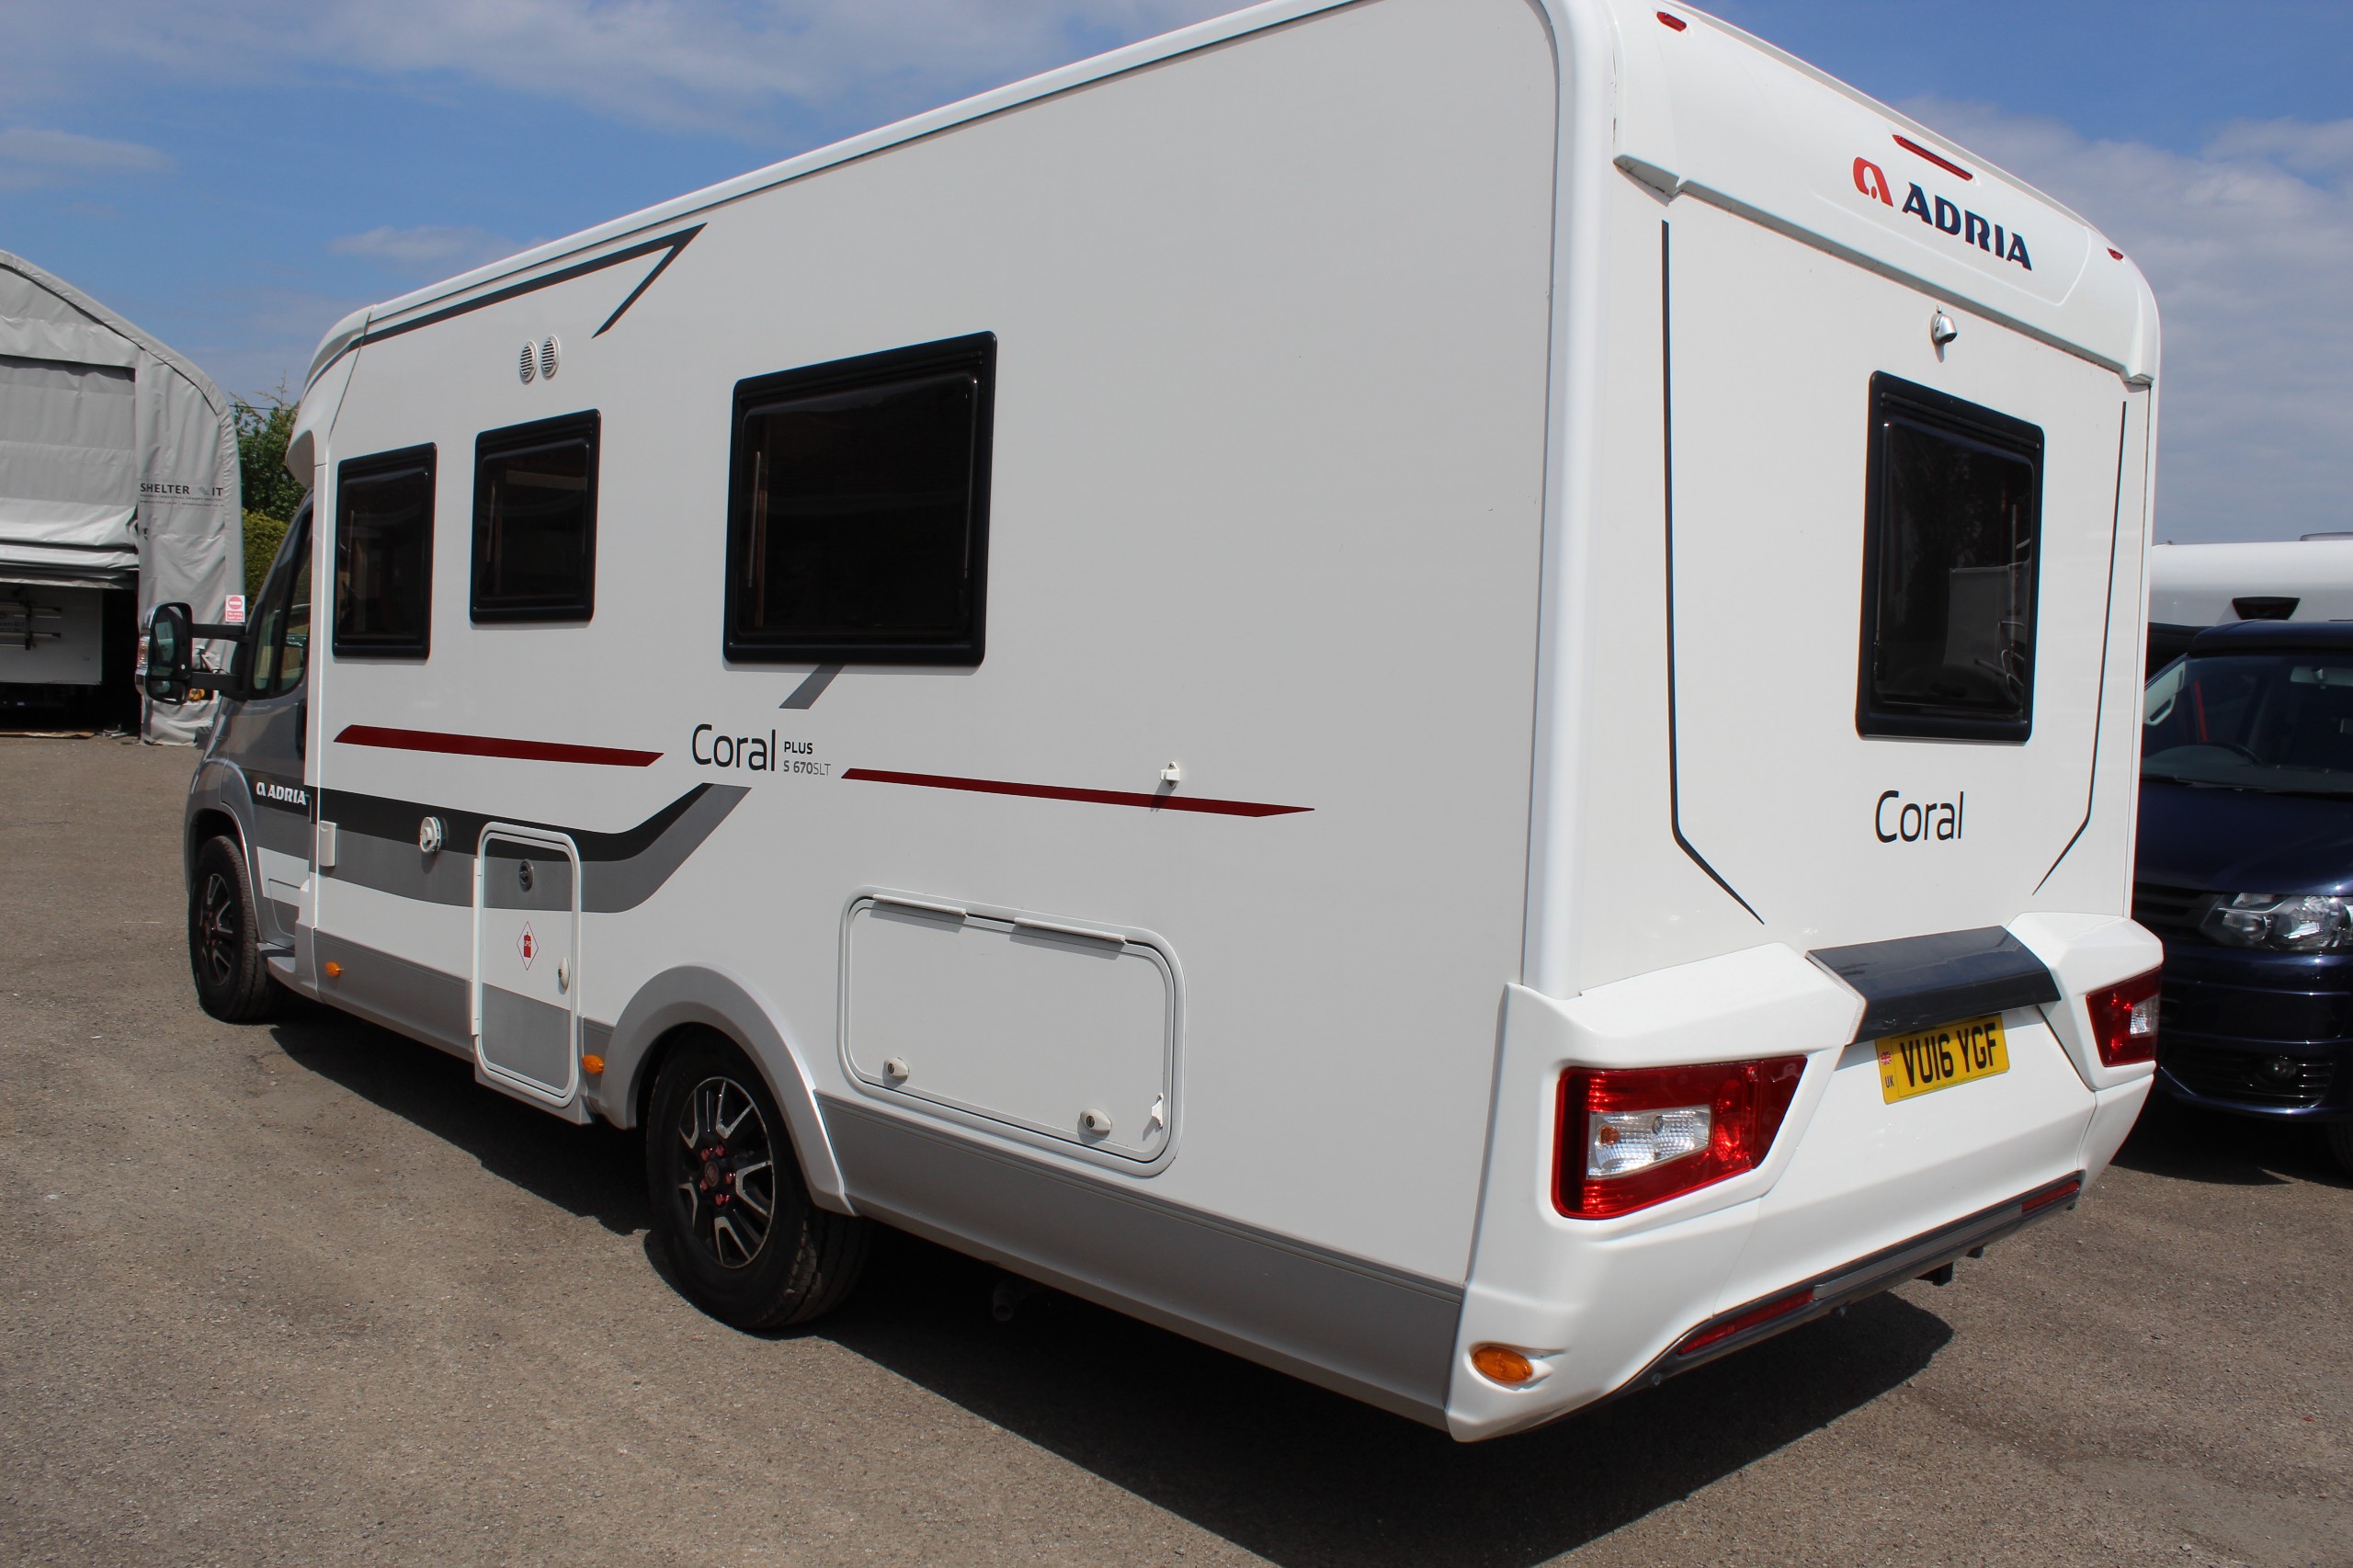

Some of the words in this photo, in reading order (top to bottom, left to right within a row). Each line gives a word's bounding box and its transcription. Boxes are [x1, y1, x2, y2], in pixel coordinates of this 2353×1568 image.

[1902, 182, 2032, 271] ADRIA
[140, 483, 190, 494] SHELTER
[692, 723, 777, 772] Coral
[784, 741, 813, 755] PLUS
[783, 760, 790, 772] S
[793, 761, 831, 776] 670SLT
[267, 784, 306, 806] ADRIA
[1875, 790, 1964, 844] Coral
[1899, 1032, 1954, 1087] VU16
[1957, 1022, 1996, 1074] YGF
[1884, 1074, 1894, 1088] UK
